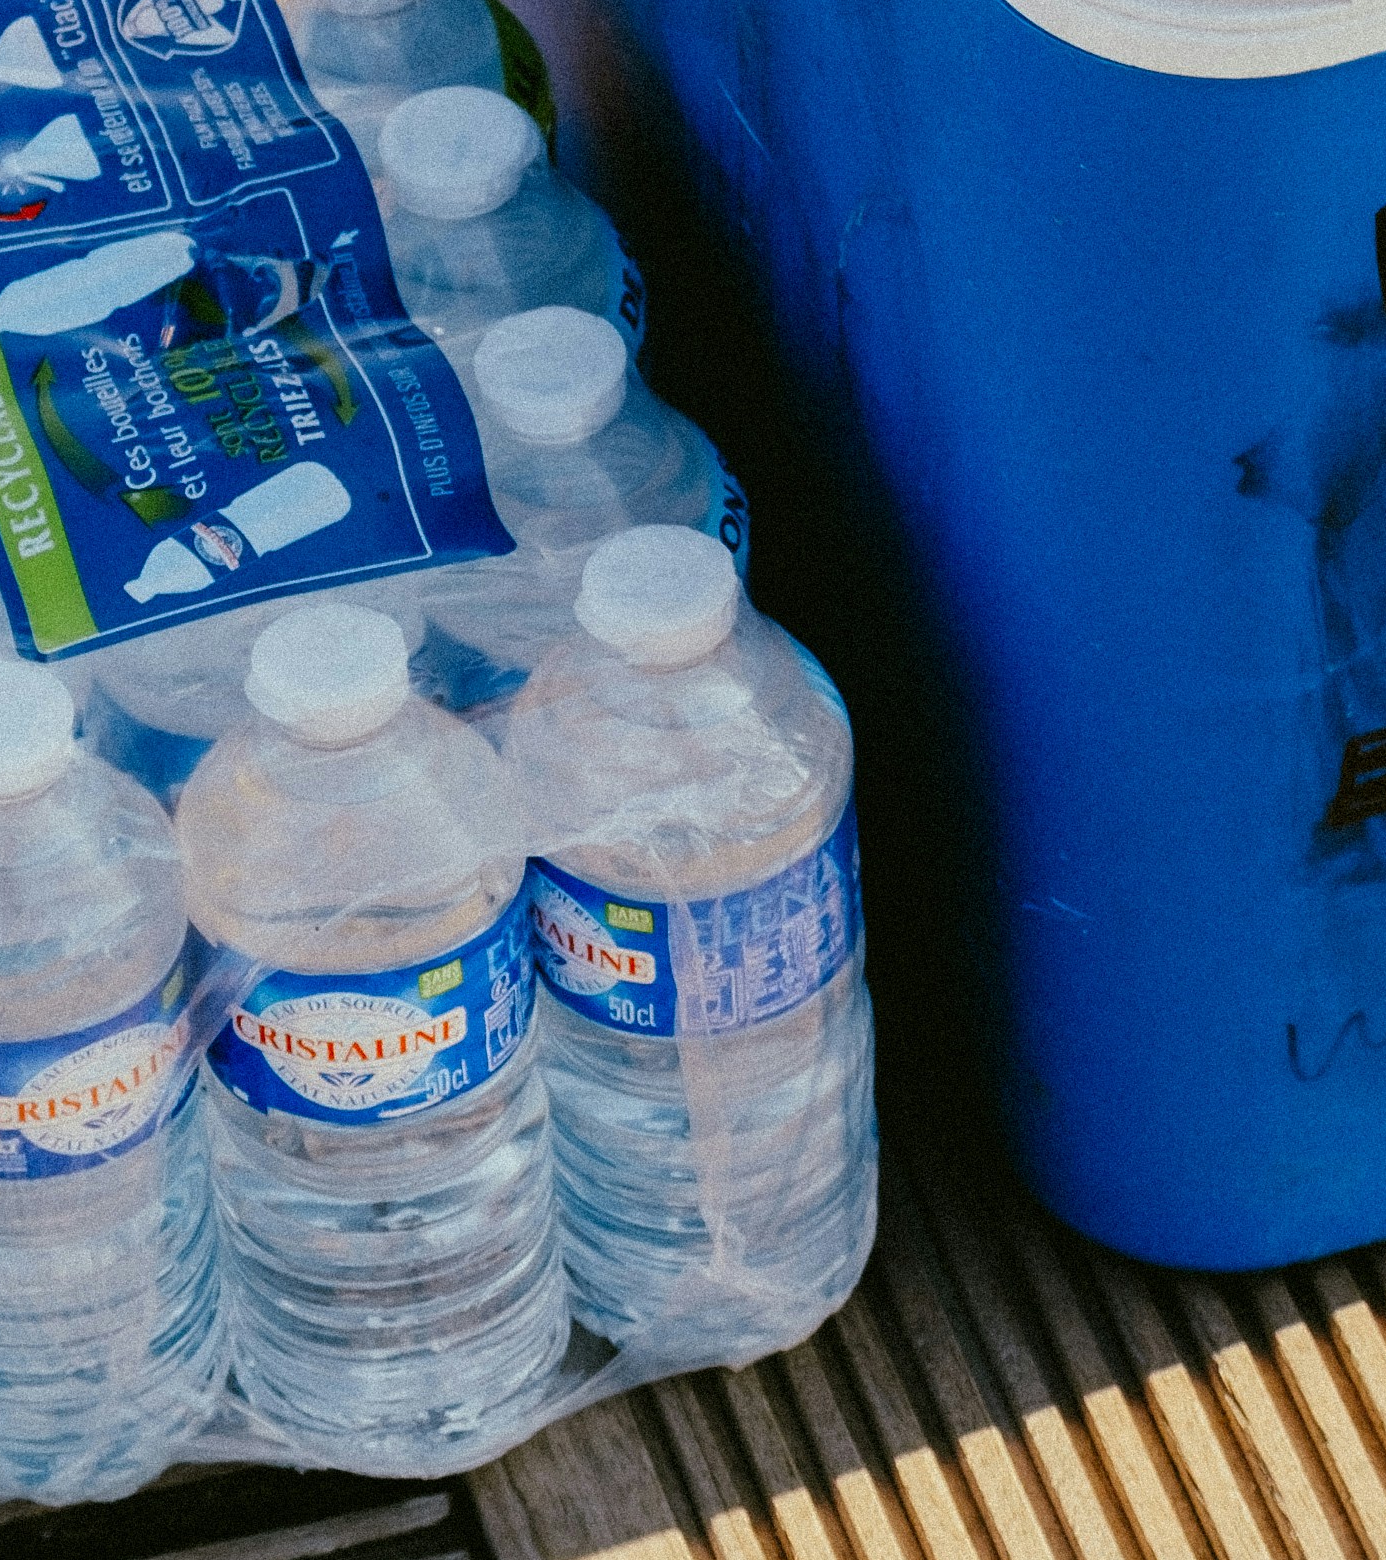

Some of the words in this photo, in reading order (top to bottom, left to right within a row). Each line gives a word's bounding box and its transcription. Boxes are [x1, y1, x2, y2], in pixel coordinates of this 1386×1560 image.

[119, 170, 152, 193] et
[161, 427, 197, 468] leur
[125, 443, 156, 491] Ces
[423, 453, 453, 496] PLUS
[183, 473, 206, 499] et
[270, 1002, 293, 1021] EAU
[308, 998, 328, 1011] DE
[608, 997, 656, 1028] 50cl
[235, 1014, 460, 1063] CRISTALINE
